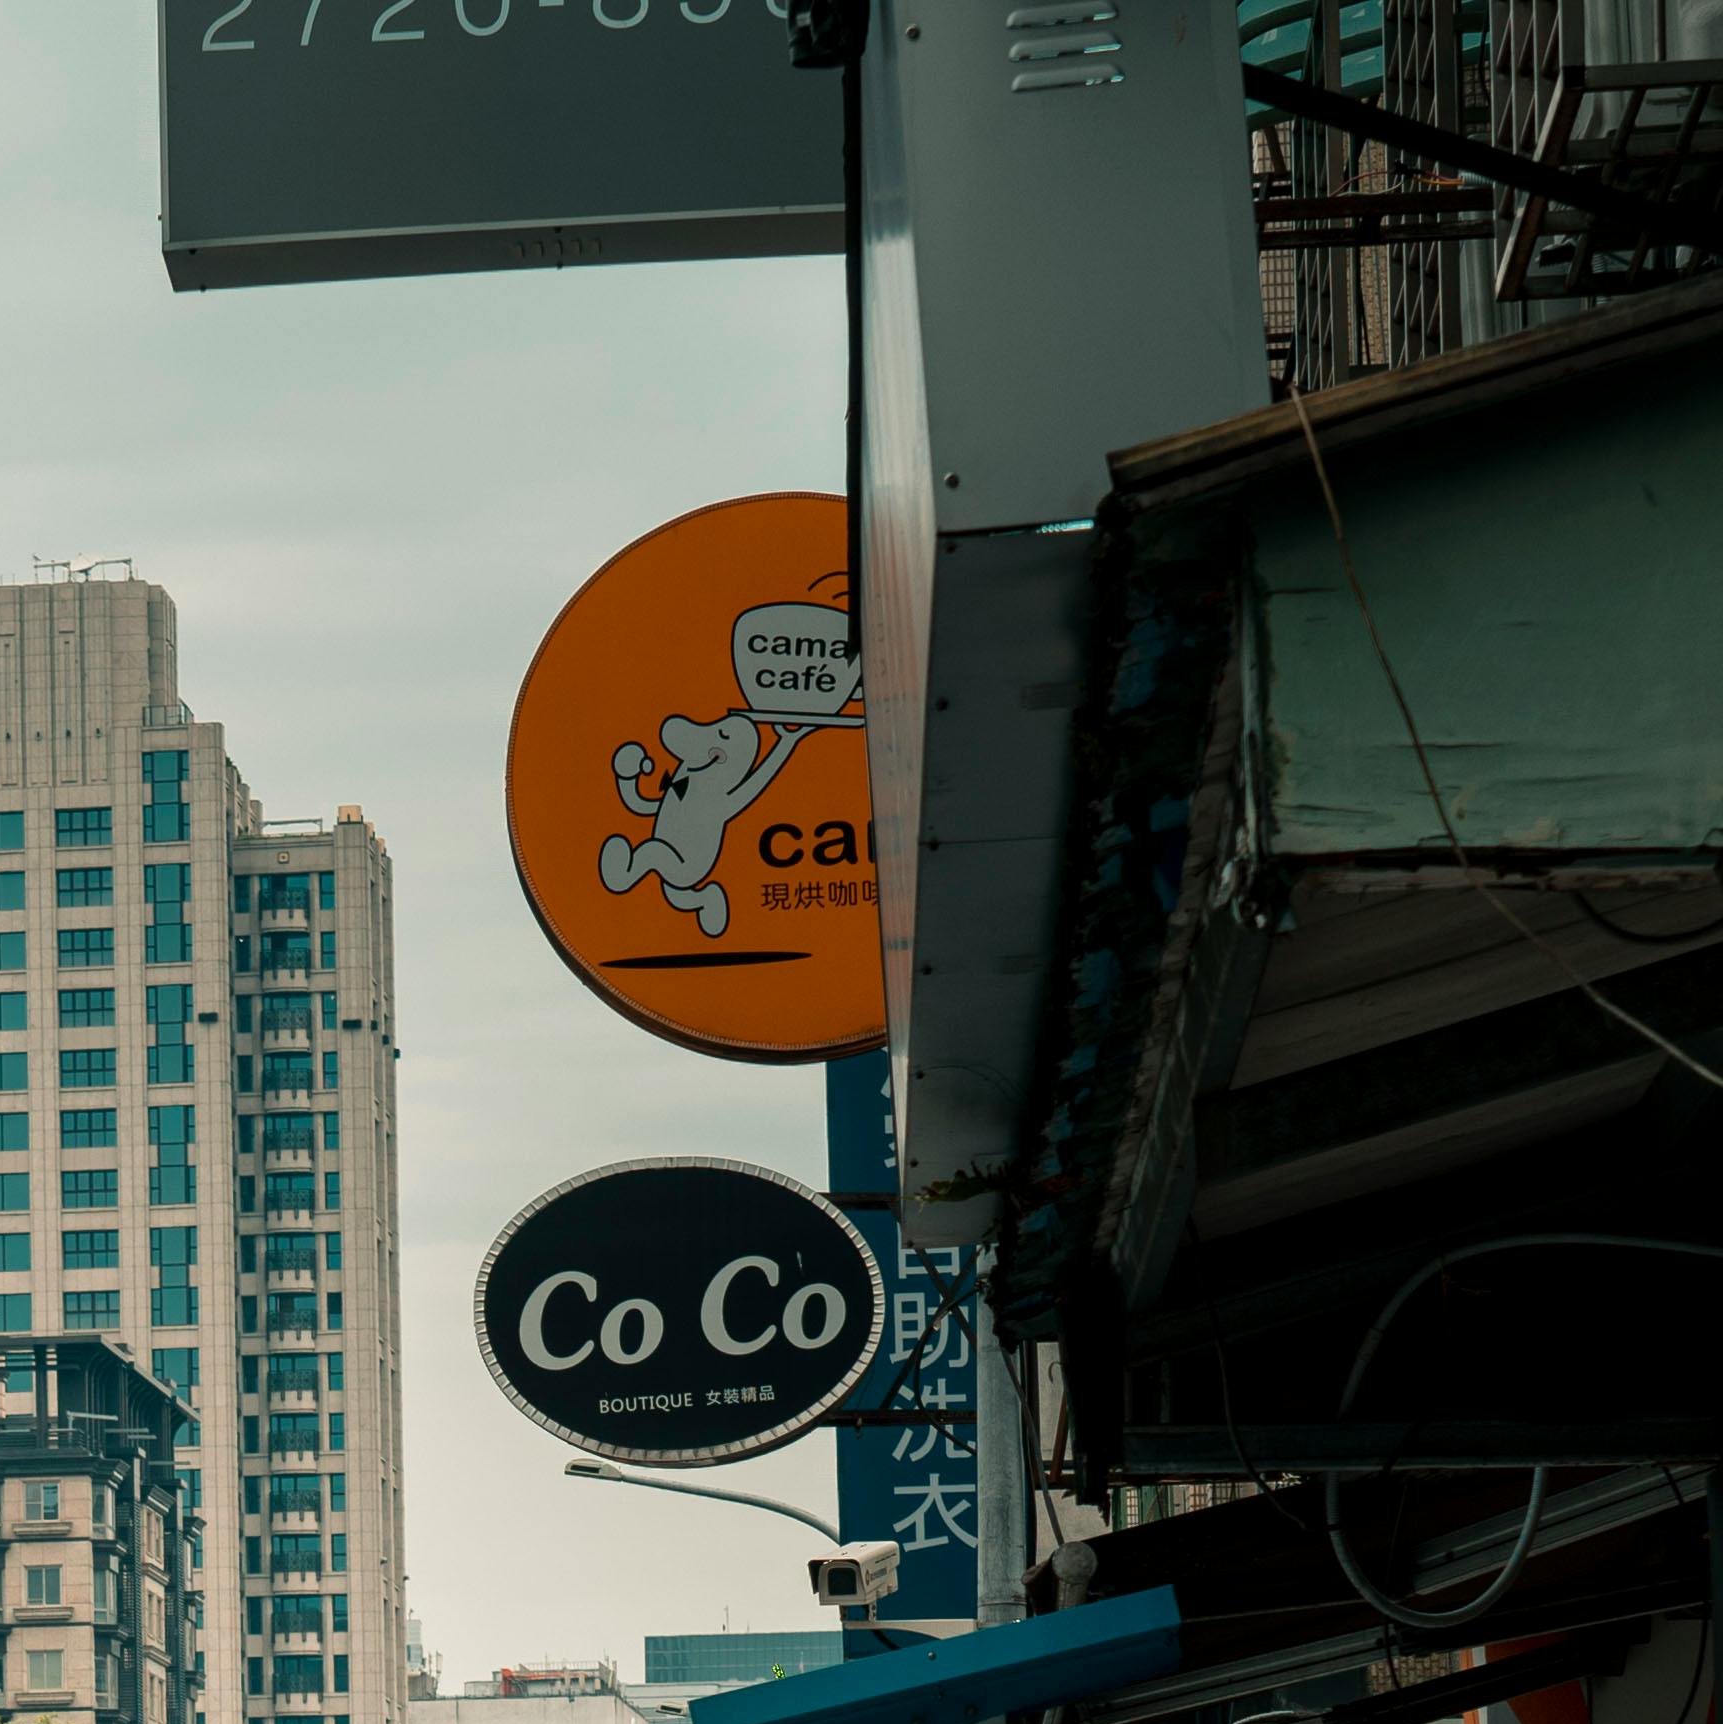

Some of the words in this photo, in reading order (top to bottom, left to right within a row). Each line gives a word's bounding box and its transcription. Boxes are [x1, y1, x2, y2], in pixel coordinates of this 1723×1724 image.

[746, 632, 850, 661] cama
[755, 663, 837, 693] café
[598, 1392, 694, 1415] BOUTIQUE
[705, 1384, 776, 1408] 女裝精品
